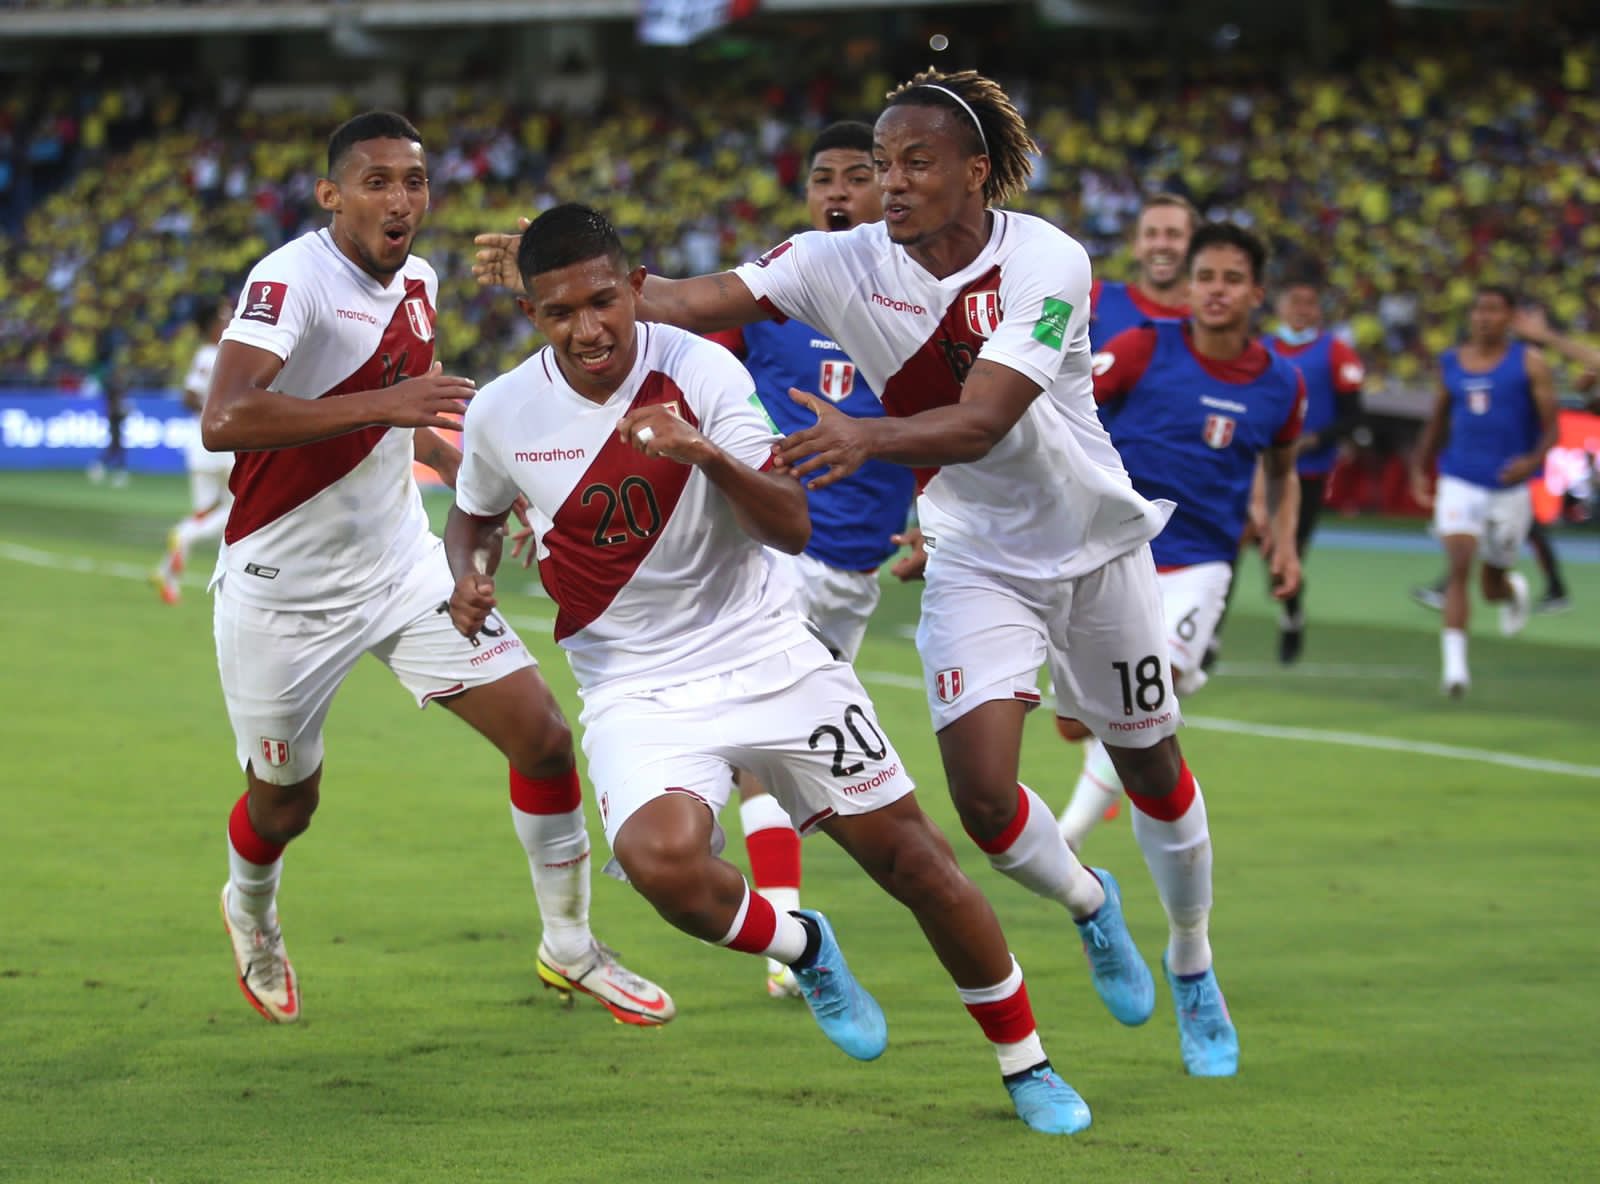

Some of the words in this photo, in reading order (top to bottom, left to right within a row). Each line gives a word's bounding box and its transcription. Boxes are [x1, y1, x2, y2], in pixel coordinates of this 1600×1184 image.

[514, 448, 585, 463] marathon
[581, 475, 662, 546] 20
[470, 639, 521, 667] maratho
[1112, 655, 1165, 716] 18
[1108, 712, 1173, 732] marathon
[808, 704, 887, 778] 20
[843, 763, 899, 797] marathon
